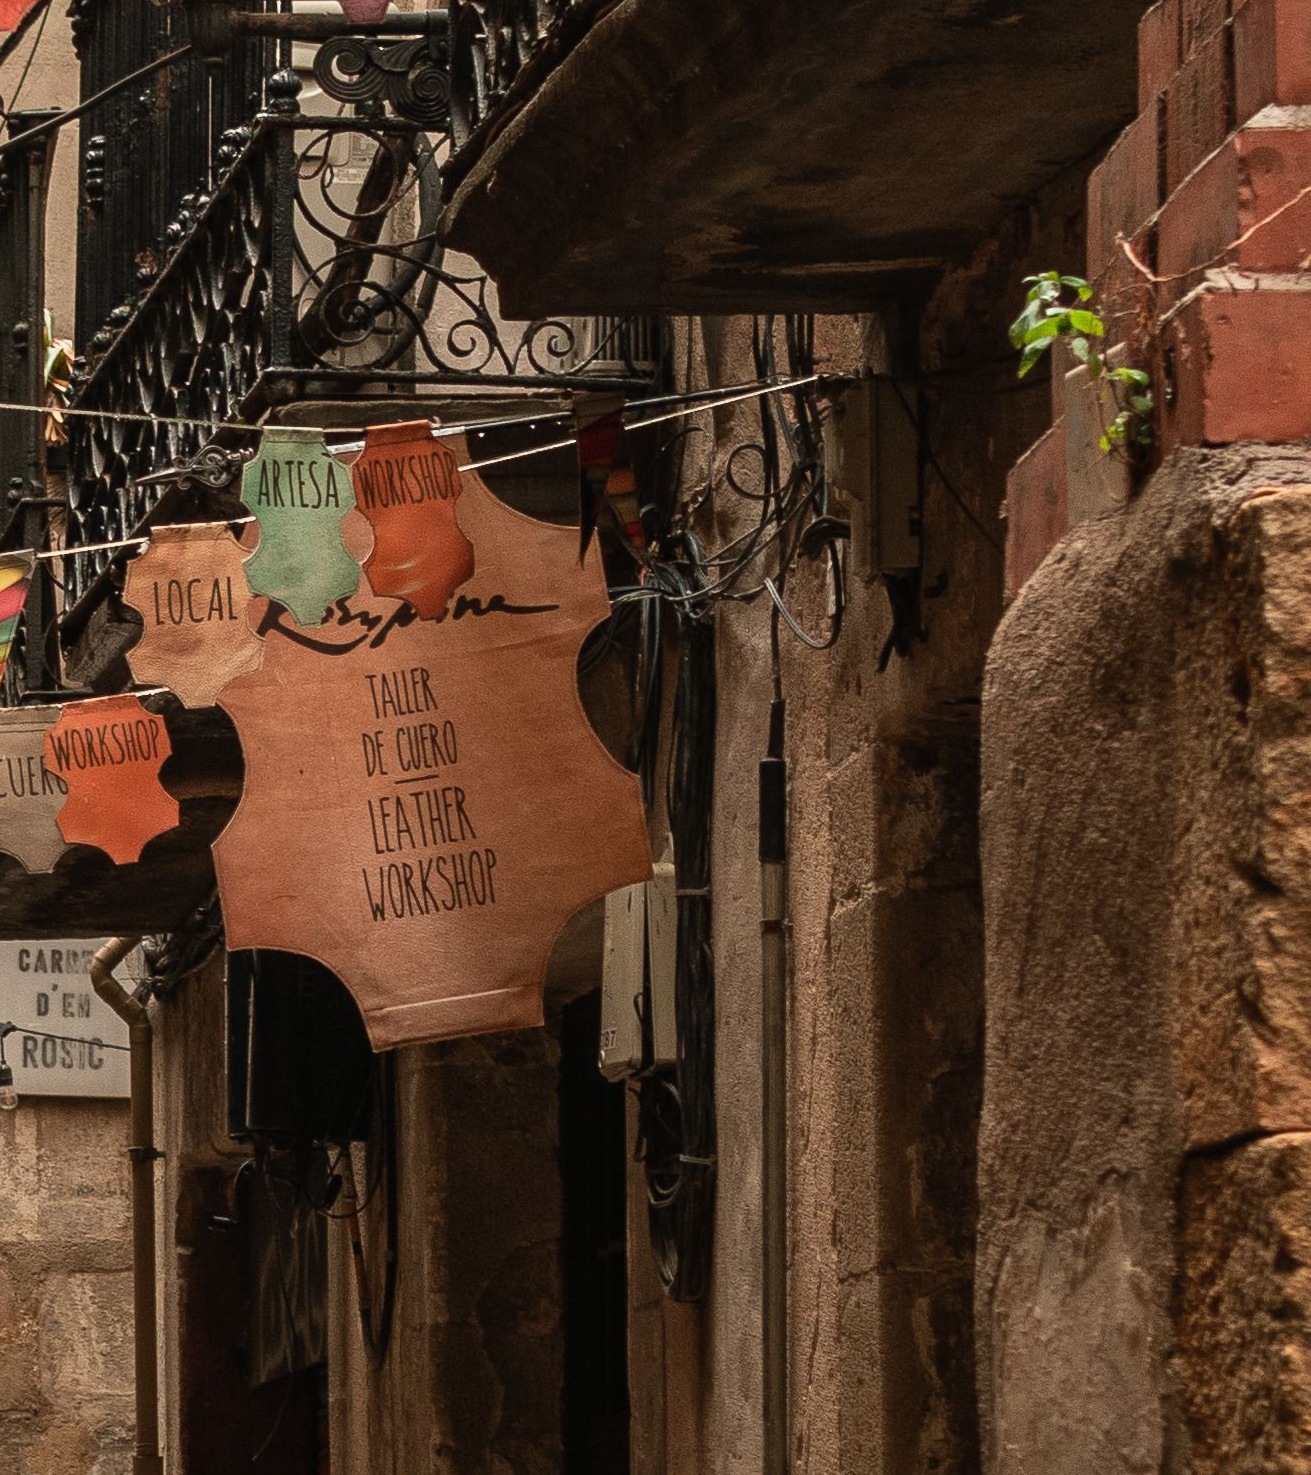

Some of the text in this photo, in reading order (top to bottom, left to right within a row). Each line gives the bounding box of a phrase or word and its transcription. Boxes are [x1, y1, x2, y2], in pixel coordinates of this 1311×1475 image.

[359, 453, 459, 511] WORKSHOP
[153, 577, 238, 626] LOCAL
[365, 667, 438, 720] TALLER
[49, 718, 159, 772] WORKSHOP
[362, 720, 459, 777] DE CUERO
[368, 785, 477, 855] LEATHER
[362, 848, 499, 923] WORKSHOP
[22, 1035, 104, 1070] ROSIC
